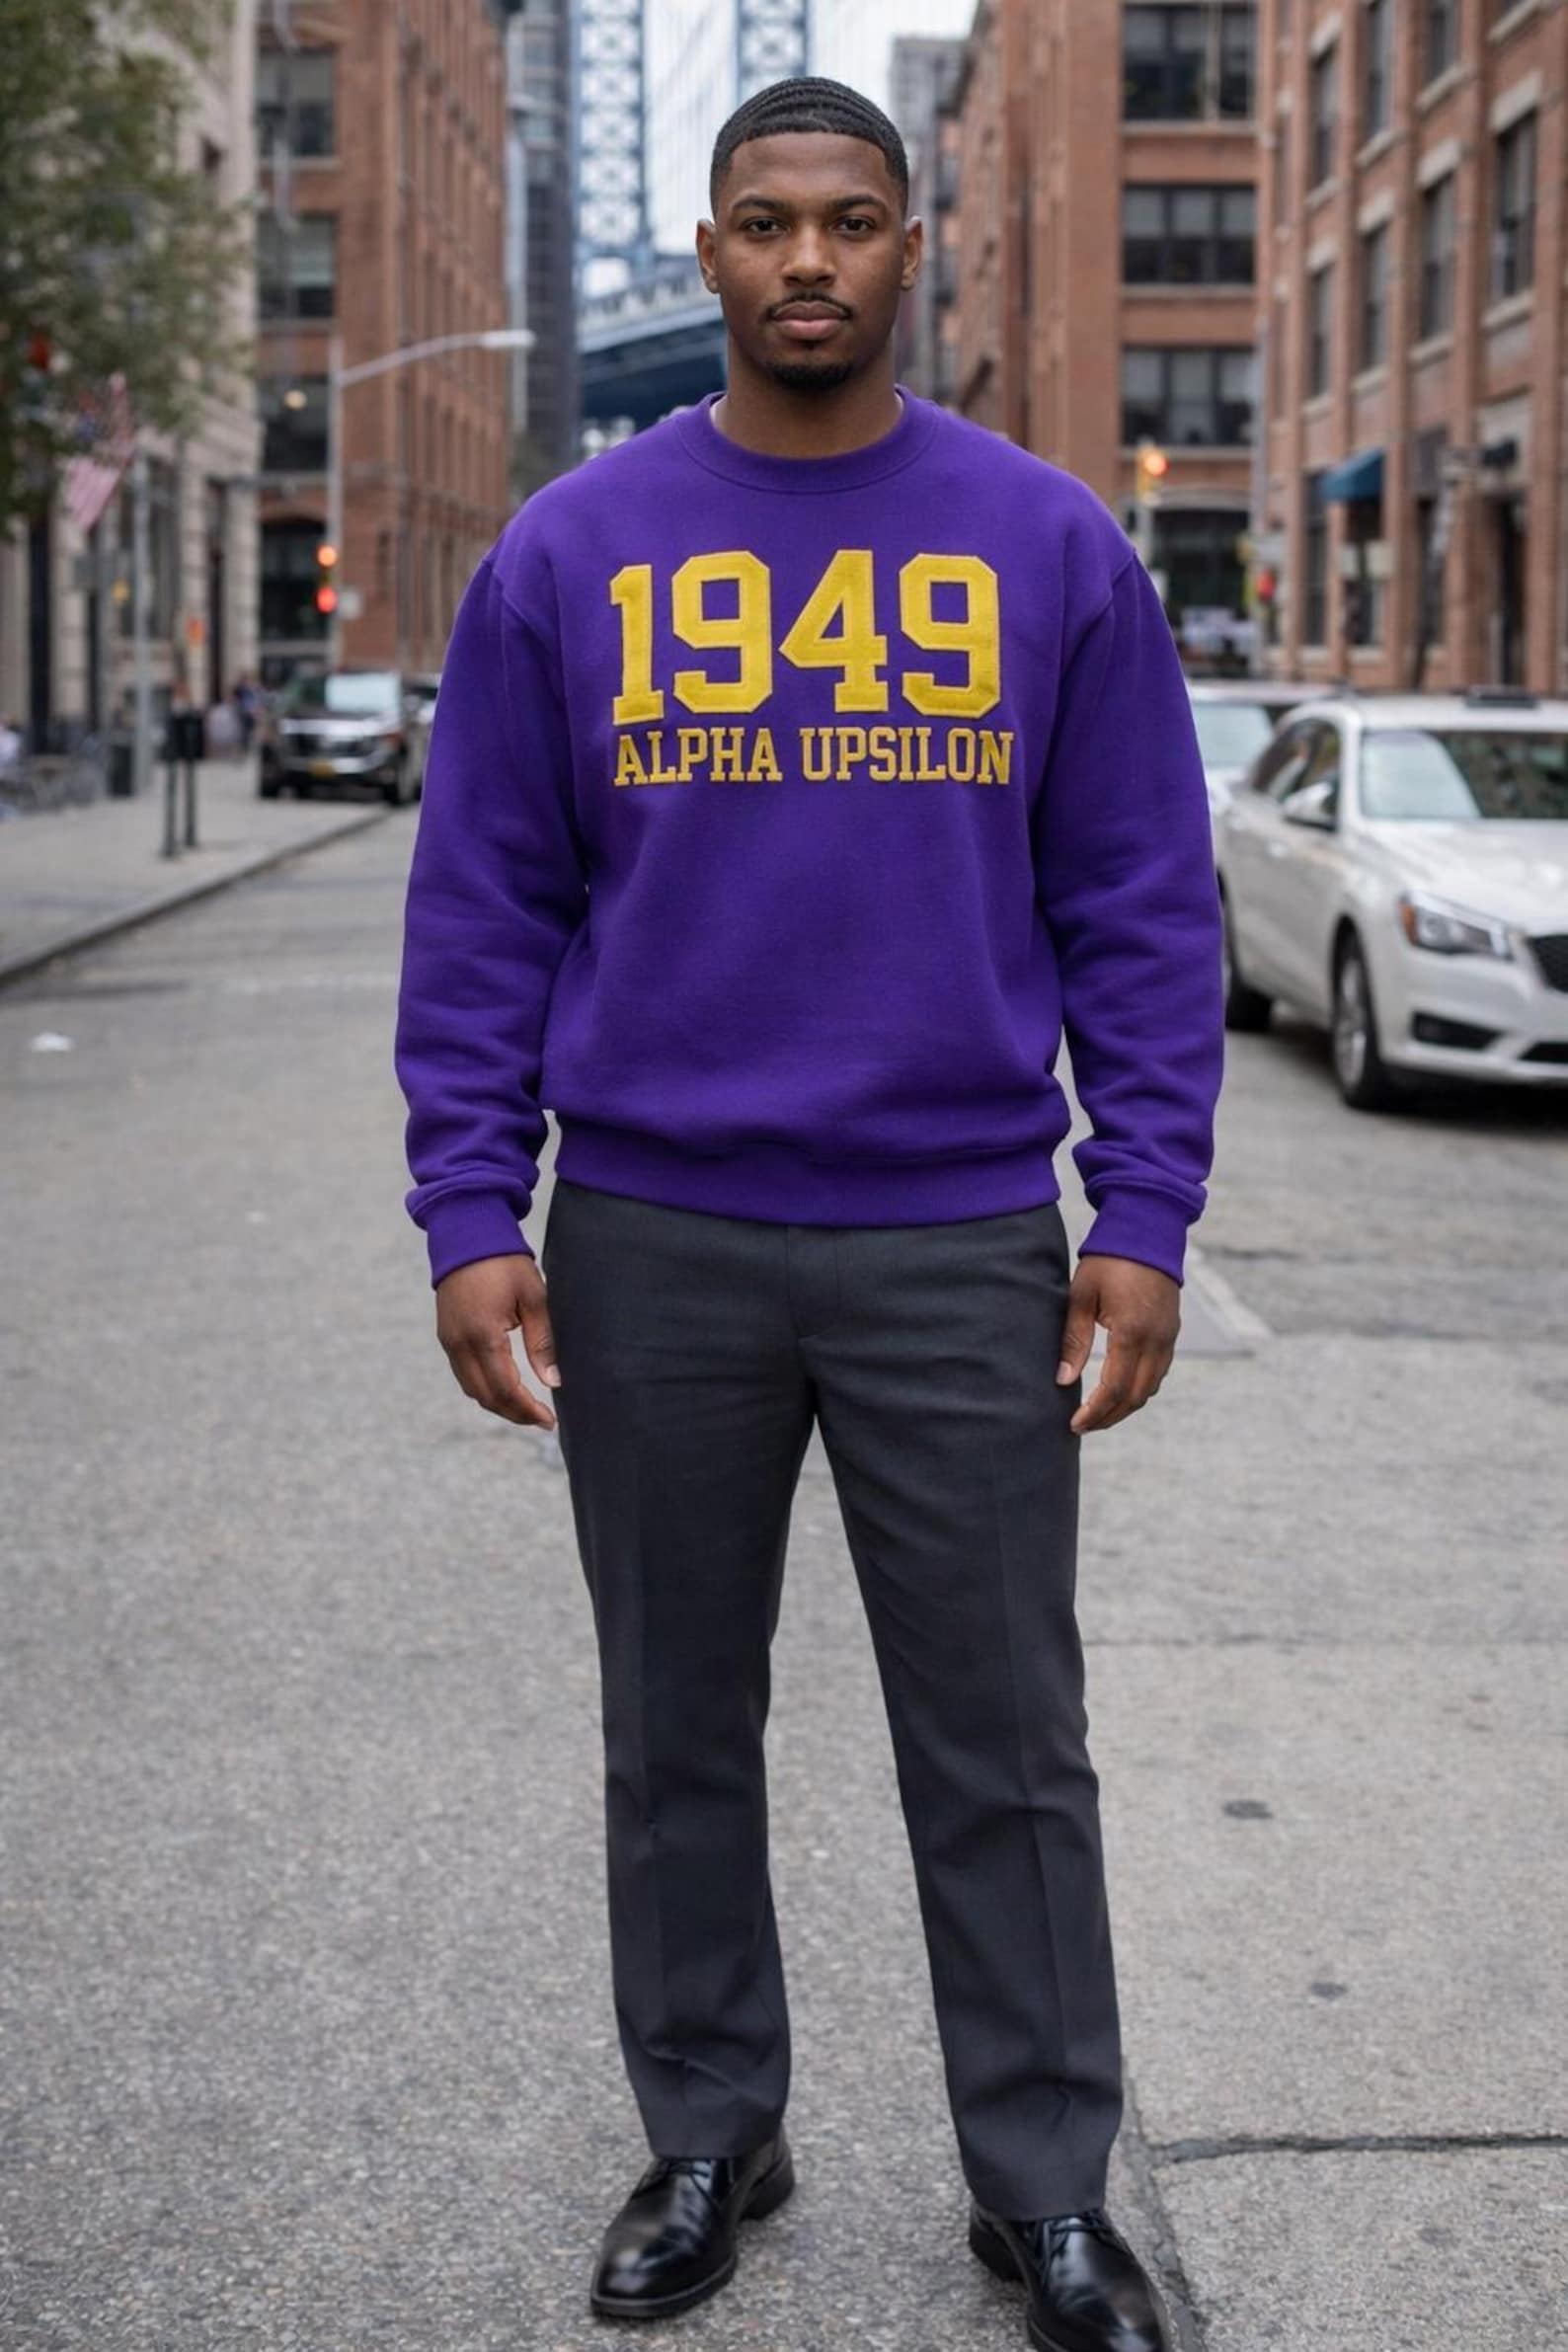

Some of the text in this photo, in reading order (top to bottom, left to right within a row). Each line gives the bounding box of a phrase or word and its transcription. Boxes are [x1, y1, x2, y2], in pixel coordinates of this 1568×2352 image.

[609, 549, 1001, 726] 1949
[613, 726, 1014, 786] ALPHA UPSILON
